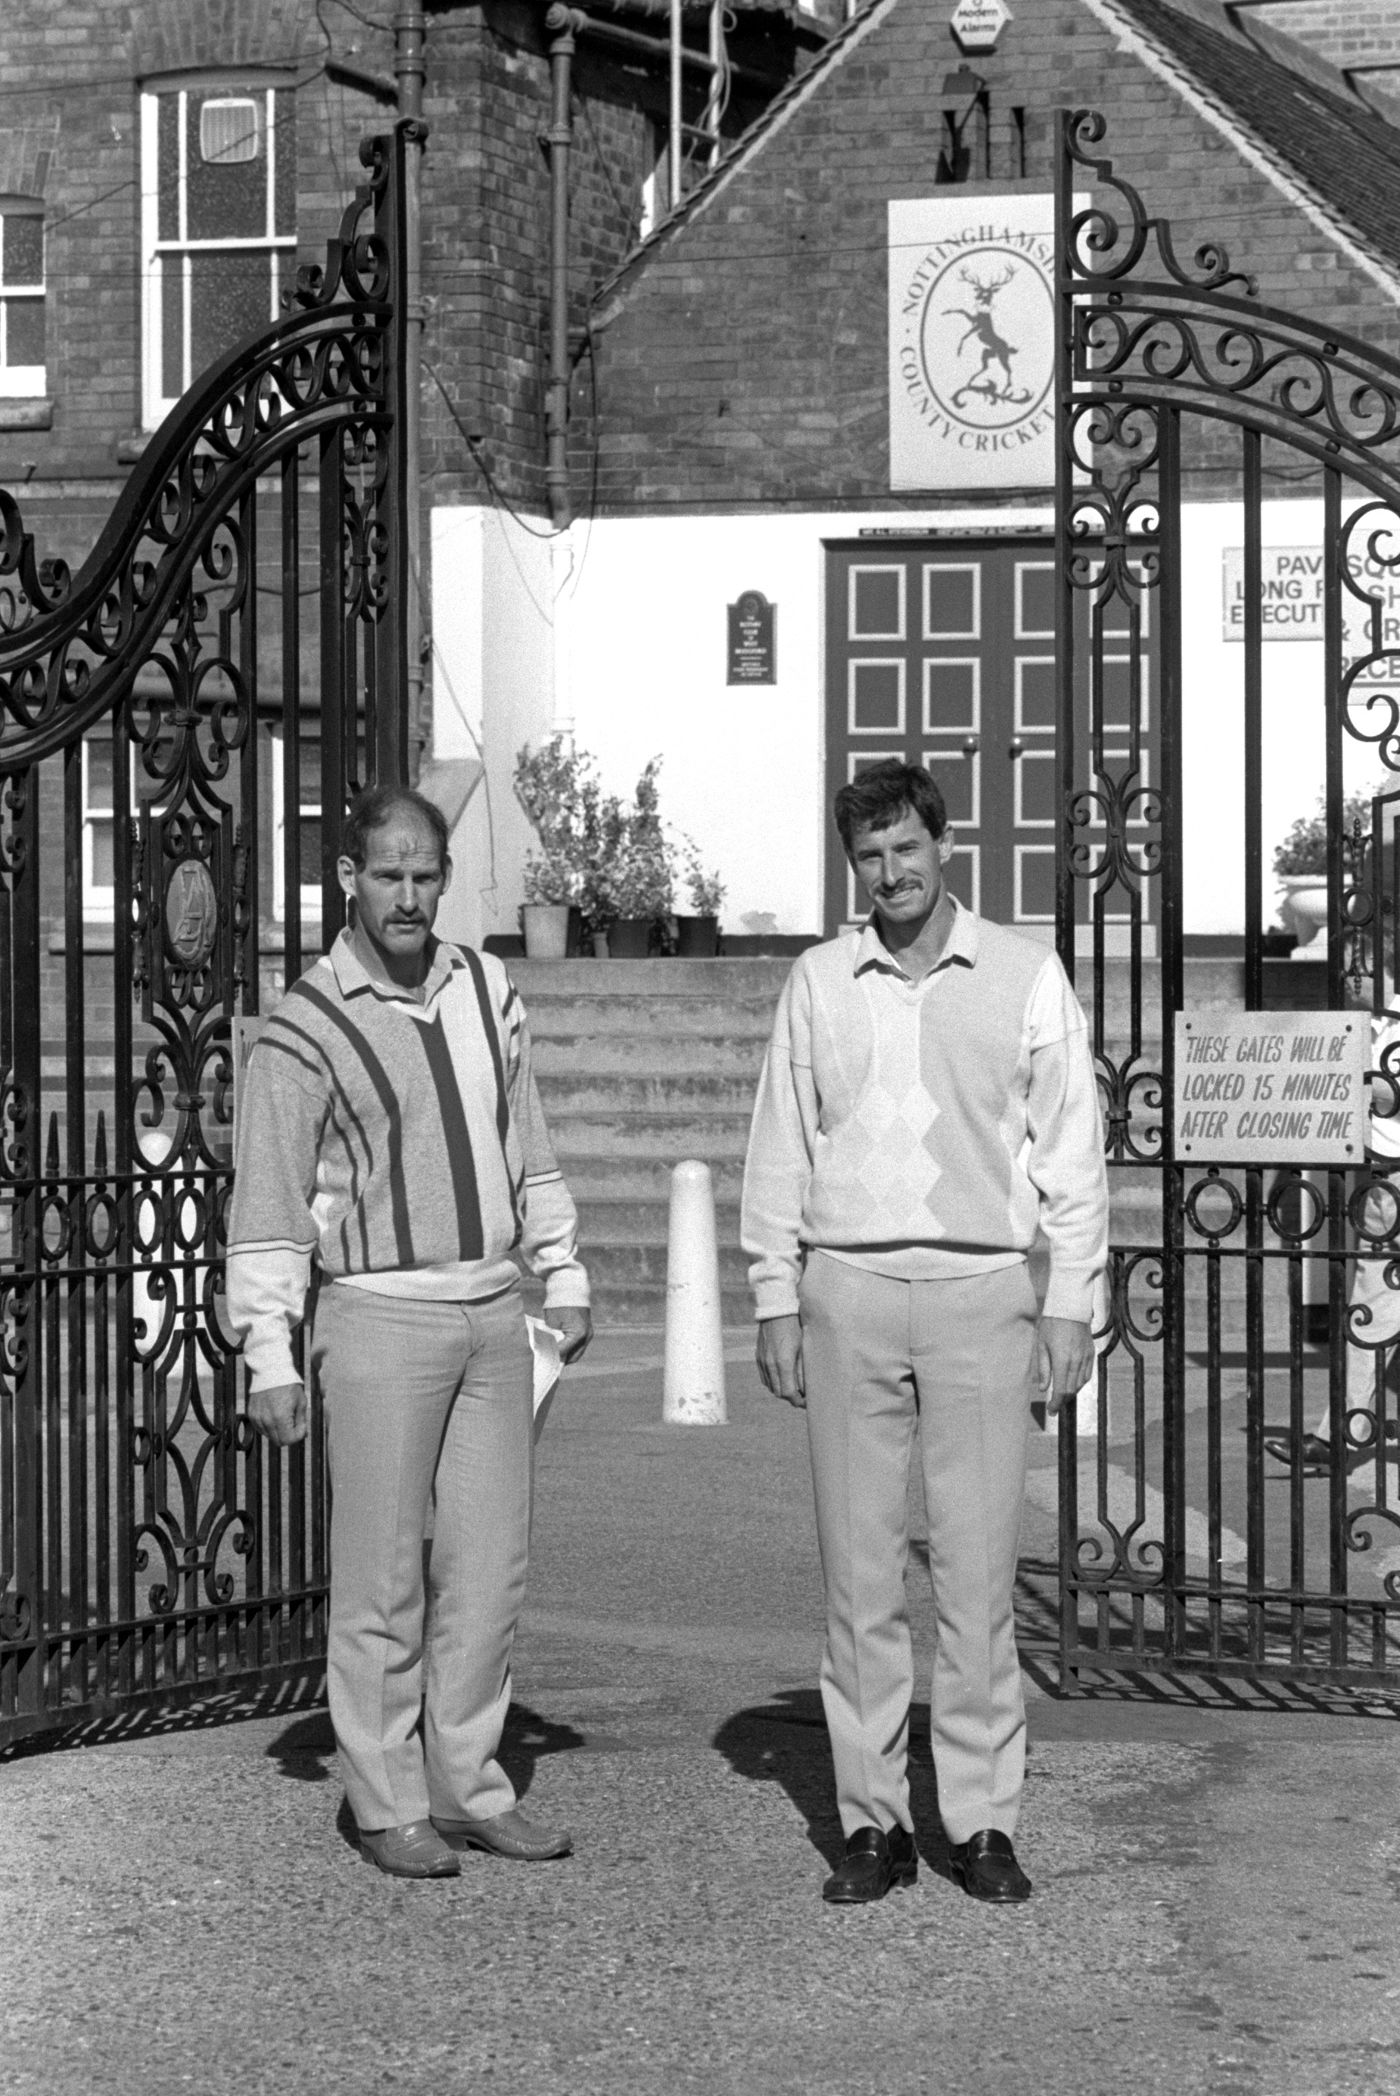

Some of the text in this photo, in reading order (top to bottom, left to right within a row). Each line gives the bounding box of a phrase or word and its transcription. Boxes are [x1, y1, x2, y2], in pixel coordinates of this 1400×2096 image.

[900, 346, 1054, 451] COUNTY CRICKET
[1236, 580, 1302, 600] LNG
[1231, 603, 1322, 624] EECUT
[1185, 1035, 1348, 1063] THESE GATES WILL BE
[1182, 1073, 1352, 1101] LOCKED 15 MINUTES
[1180, 1111, 1354, 1139] AFTER CLOSING TIME
